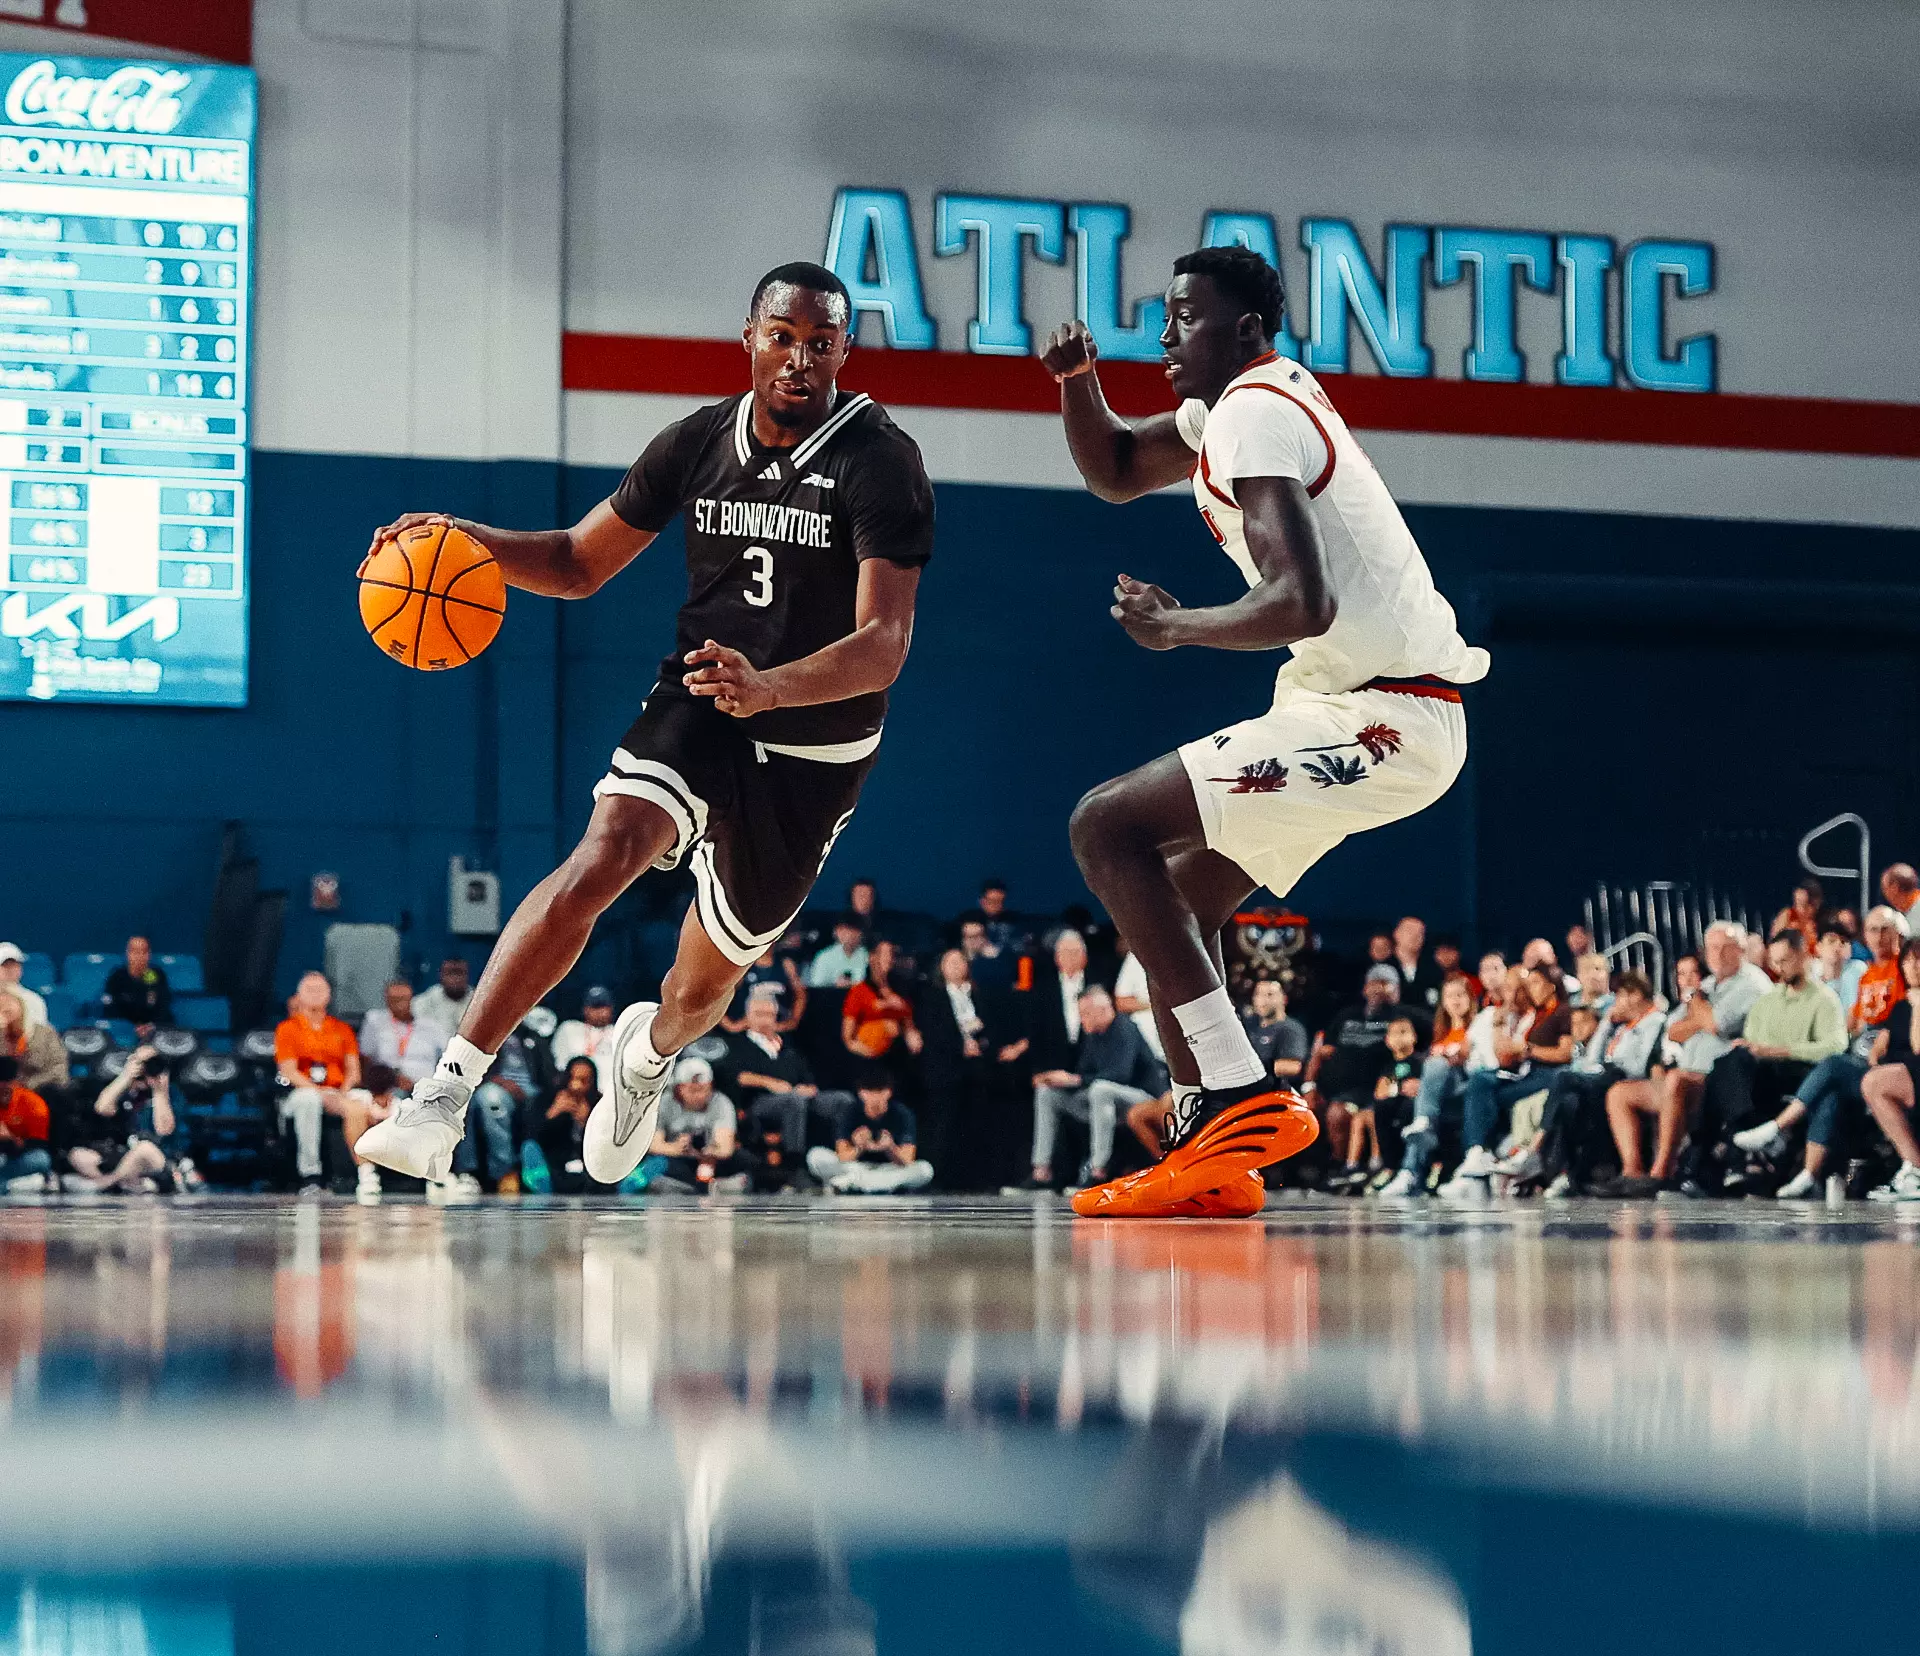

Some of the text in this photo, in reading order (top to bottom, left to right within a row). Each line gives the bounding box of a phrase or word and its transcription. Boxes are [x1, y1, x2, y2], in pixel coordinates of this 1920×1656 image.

[0, 136, 240, 184] BONAVENTURE
[695, 498, 832, 548] ST. BONAVENTURE
[743, 546, 774, 608] 3
